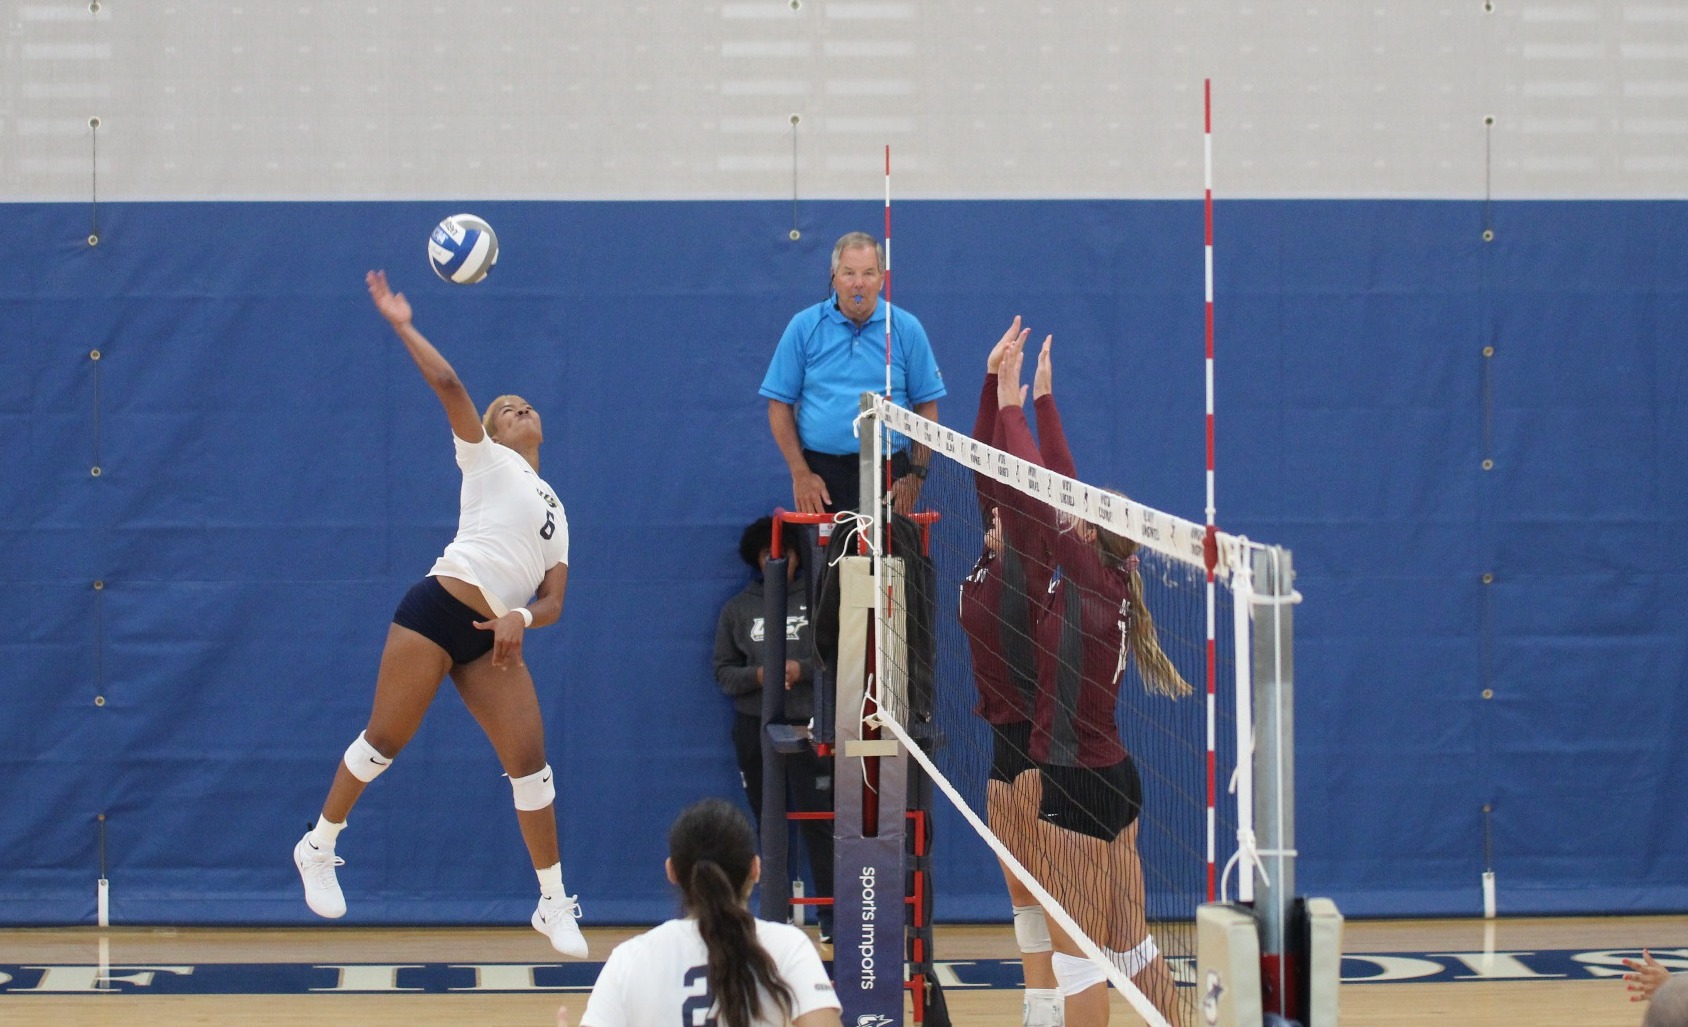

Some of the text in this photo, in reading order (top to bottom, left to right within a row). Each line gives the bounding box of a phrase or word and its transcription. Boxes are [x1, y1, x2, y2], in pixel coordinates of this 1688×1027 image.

[539, 508, 556, 541] 6
[858, 866, 877, 921] sports
[0, 966, 195, 992] F
